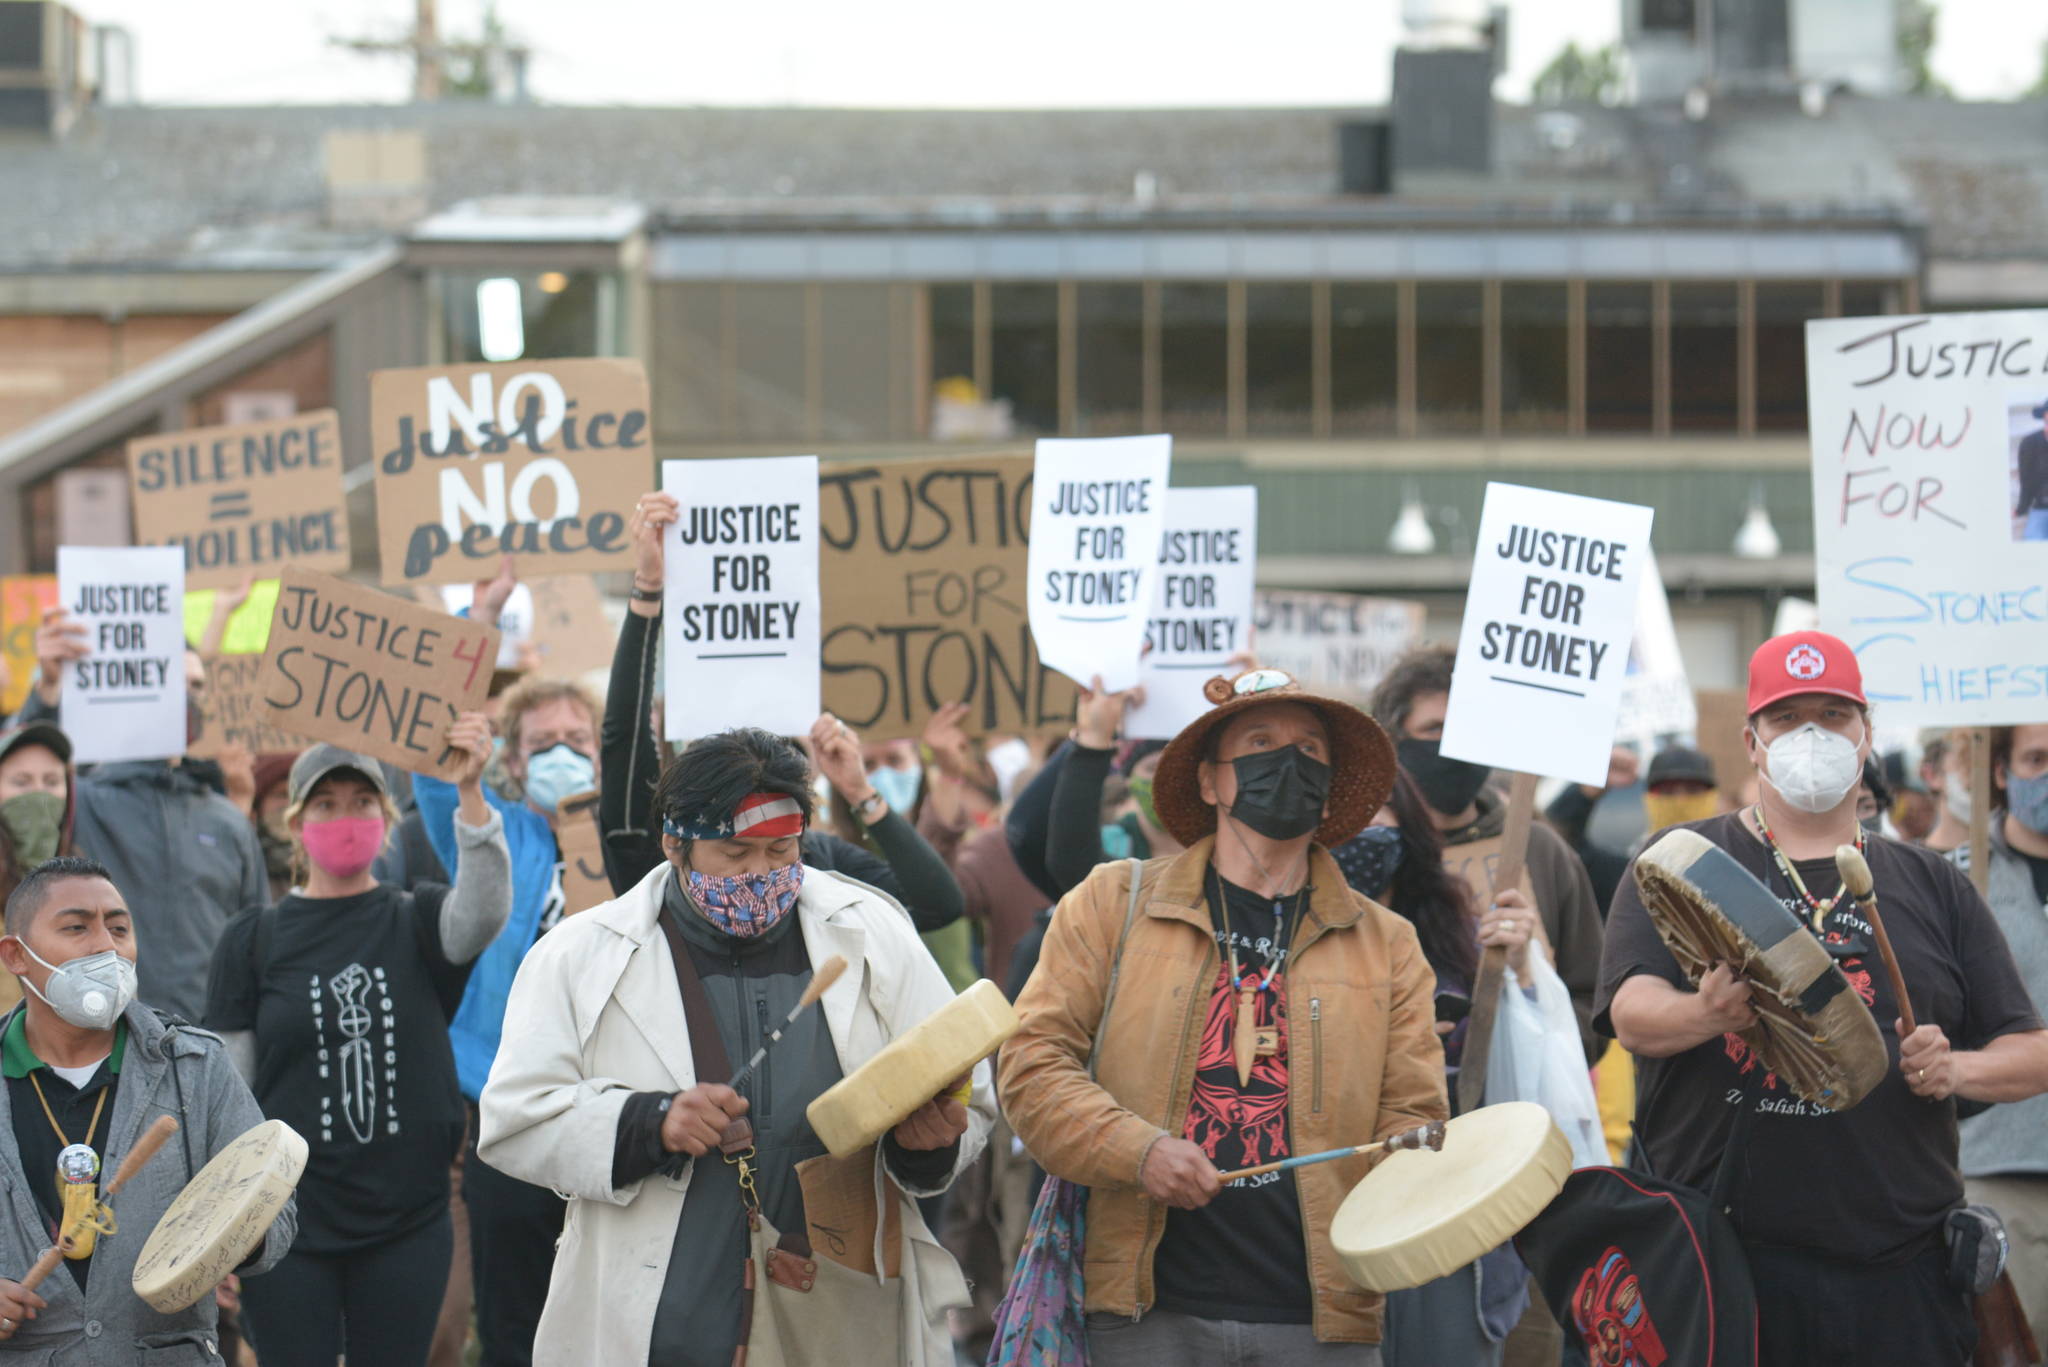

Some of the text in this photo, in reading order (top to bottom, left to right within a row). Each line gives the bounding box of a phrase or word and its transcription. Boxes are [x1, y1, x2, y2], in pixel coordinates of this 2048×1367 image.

[1837, 318, 2048, 388] JUSTIC
[427, 371, 567, 454] NO
[1841, 403, 1971, 464] NOW
[138, 422, 335, 491] SILENCE
[439, 457, 580, 543] NO
[681, 504, 801, 545] JUSTICE
[819, 469, 1034, 554] JUSTIC
[1050, 479, 1152, 516] JUSTICE
[1840, 466, 1967, 529] FOR
[146, 509, 340, 573] IOLENCE
[403, 512, 630, 579] peace
[1075, 526, 1125, 561] FOR
[1497, 524, 1627, 581] JUSTICE
[74, 584, 170, 615] JUSTICE
[712, 554, 771, 593] FOR
[905, 564, 1022, 626] FOR
[1045, 568, 1142, 606] STONEY
[1166, 574, 1216, 608] FOR
[1520, 575, 1586, 626] FOR
[1844, 556, 2048, 627] STONEC
[99, 623, 146, 652] FOR
[282, 585, 489, 691] JUSTICE 4
[683, 601, 801, 642] STONEY
[1480, 621, 1609, 681] STONEY
[76, 659, 170, 690] STONEY
[821, 622, 1080, 731] STONE
[309, 974, 334, 1142] JUSTICE FOR
[372, 966, 400, 1136] STONECHILD
[1755, 1098, 1807, 1117] Salish
[1248, 1170, 1281, 1189] Sea
